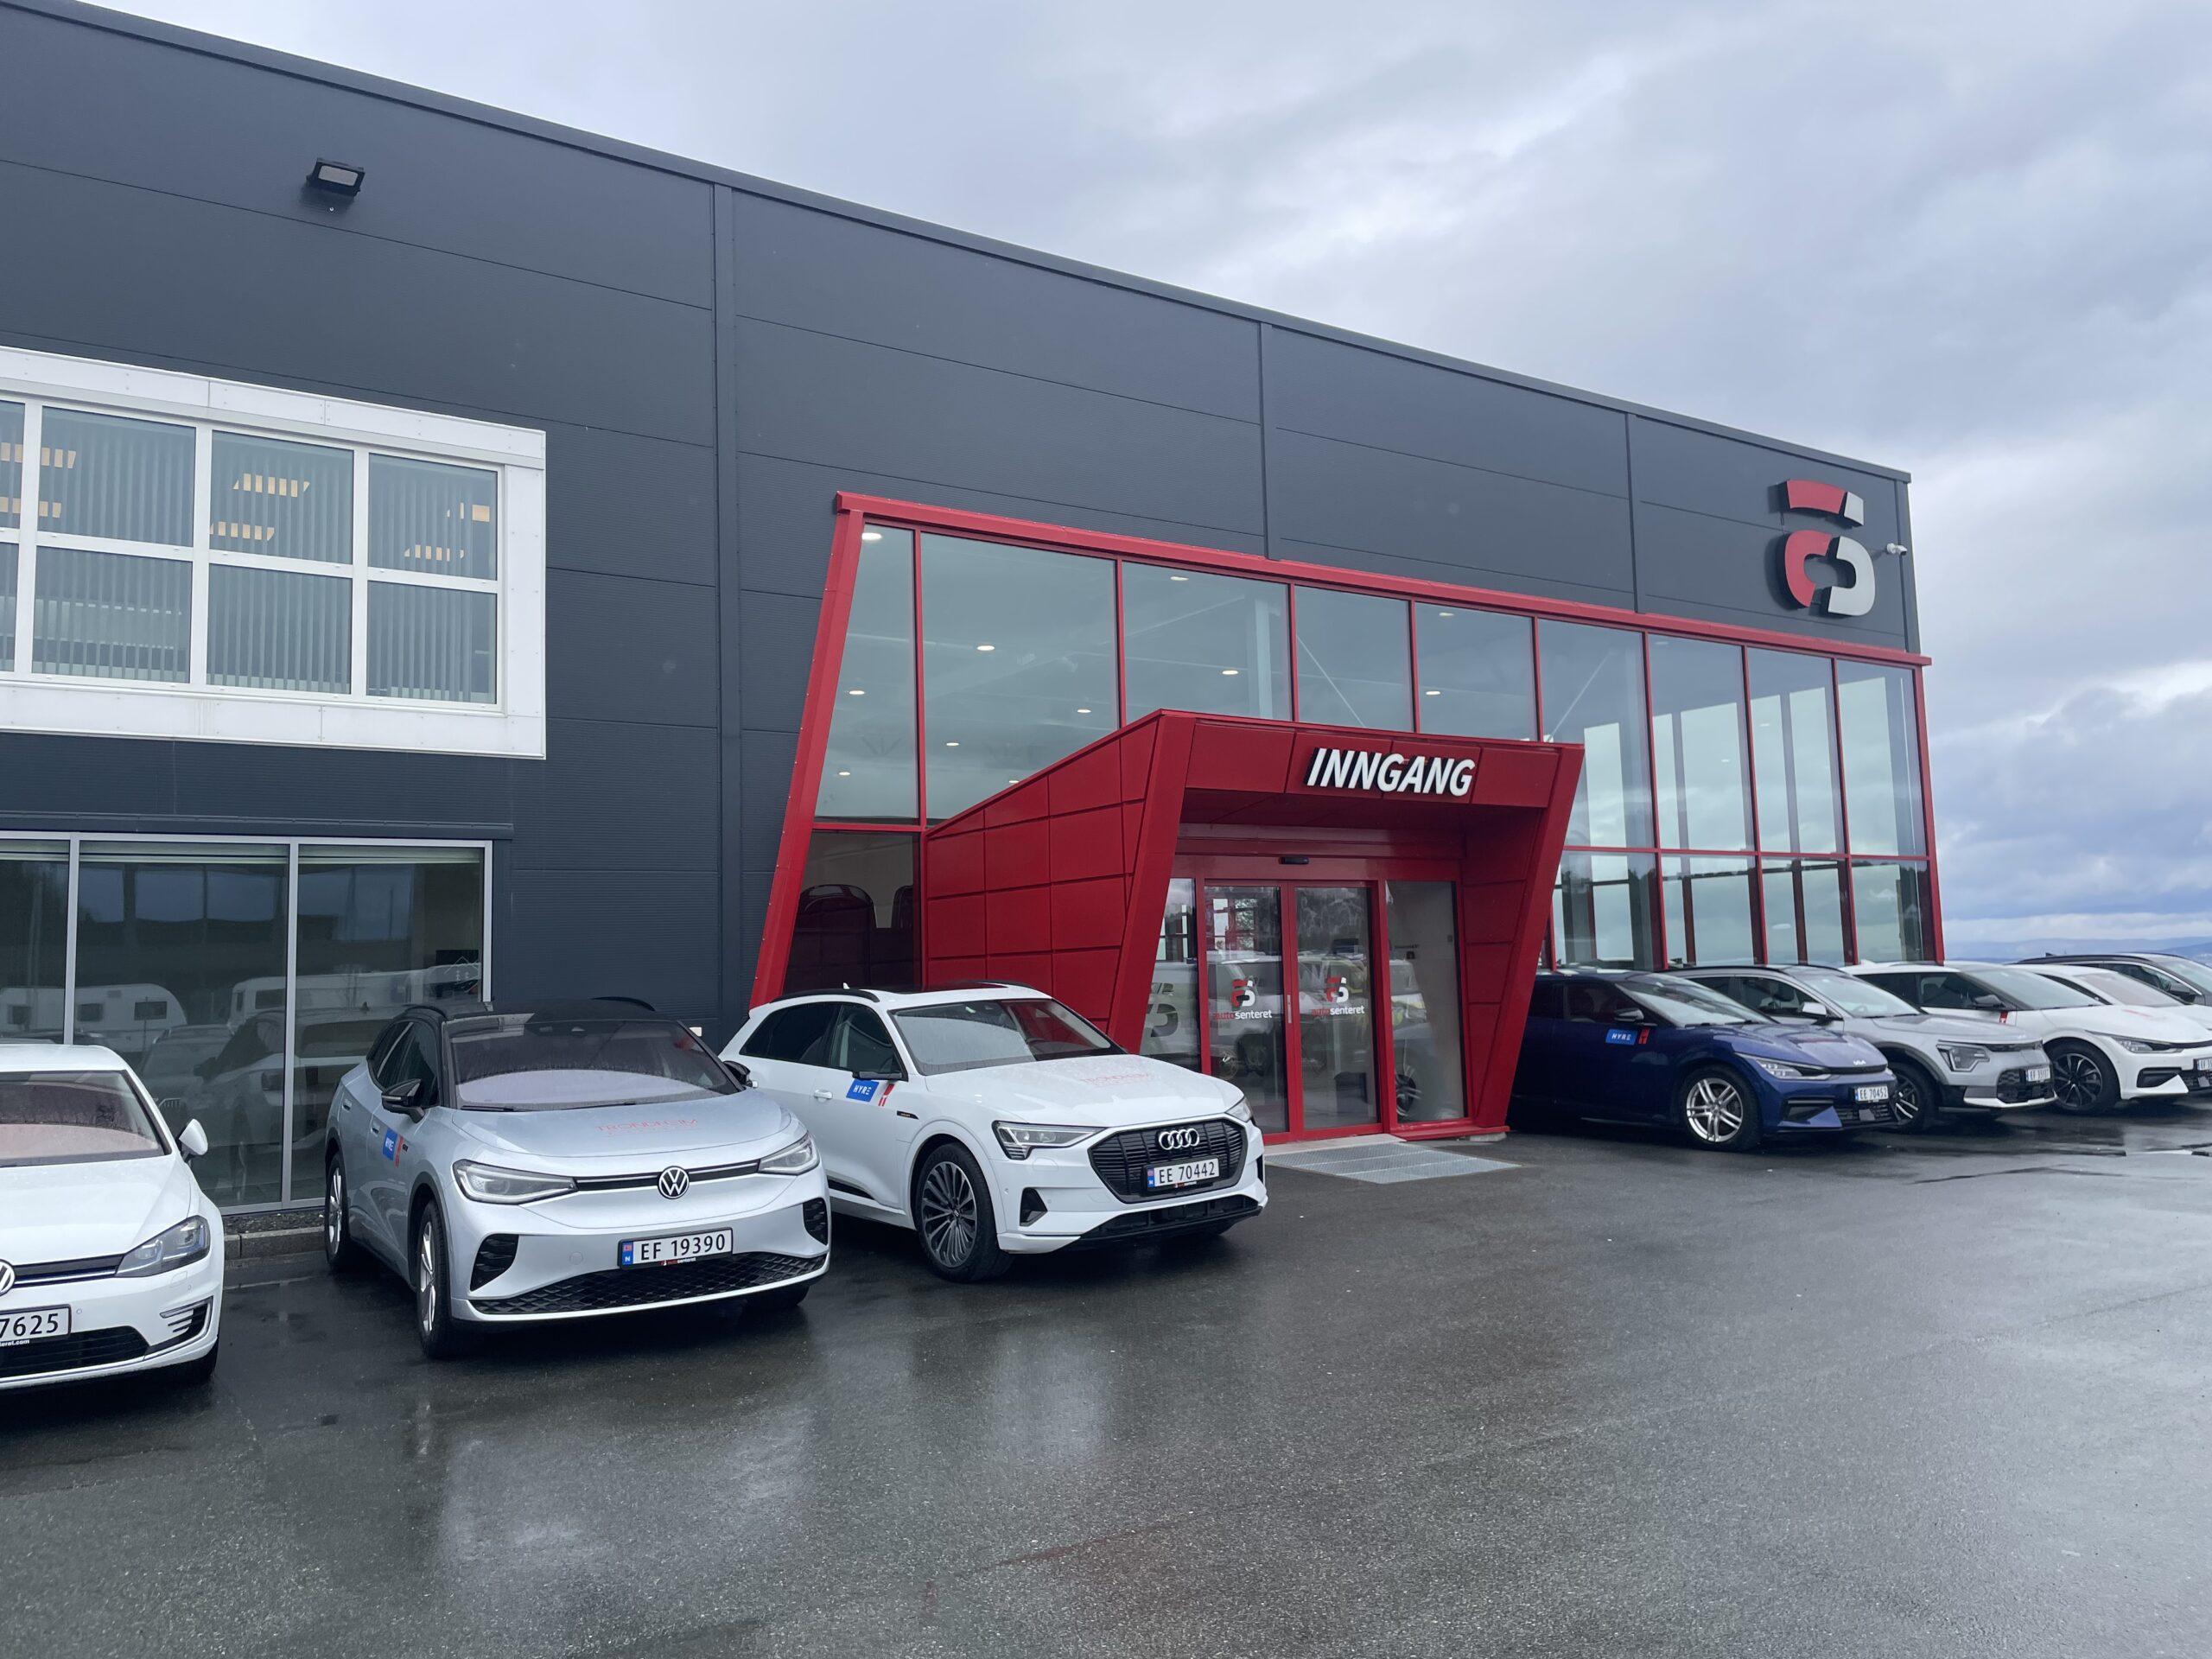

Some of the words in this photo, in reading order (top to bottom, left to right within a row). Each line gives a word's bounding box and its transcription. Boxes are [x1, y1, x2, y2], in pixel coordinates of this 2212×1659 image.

[1306, 747, 1476, 797] INNGANG
[1611, 1033, 1631, 1041] HYRE
[853, 1084, 872, 1096] HYRE
[1159, 1168, 1173, 1184] EE
[1179, 1161, 1216, 1181] 70442
[640, 1242, 662, 1261] EF
[671, 1234, 726, 1257] 19390
[0, 1313, 59, 1338] 7625
